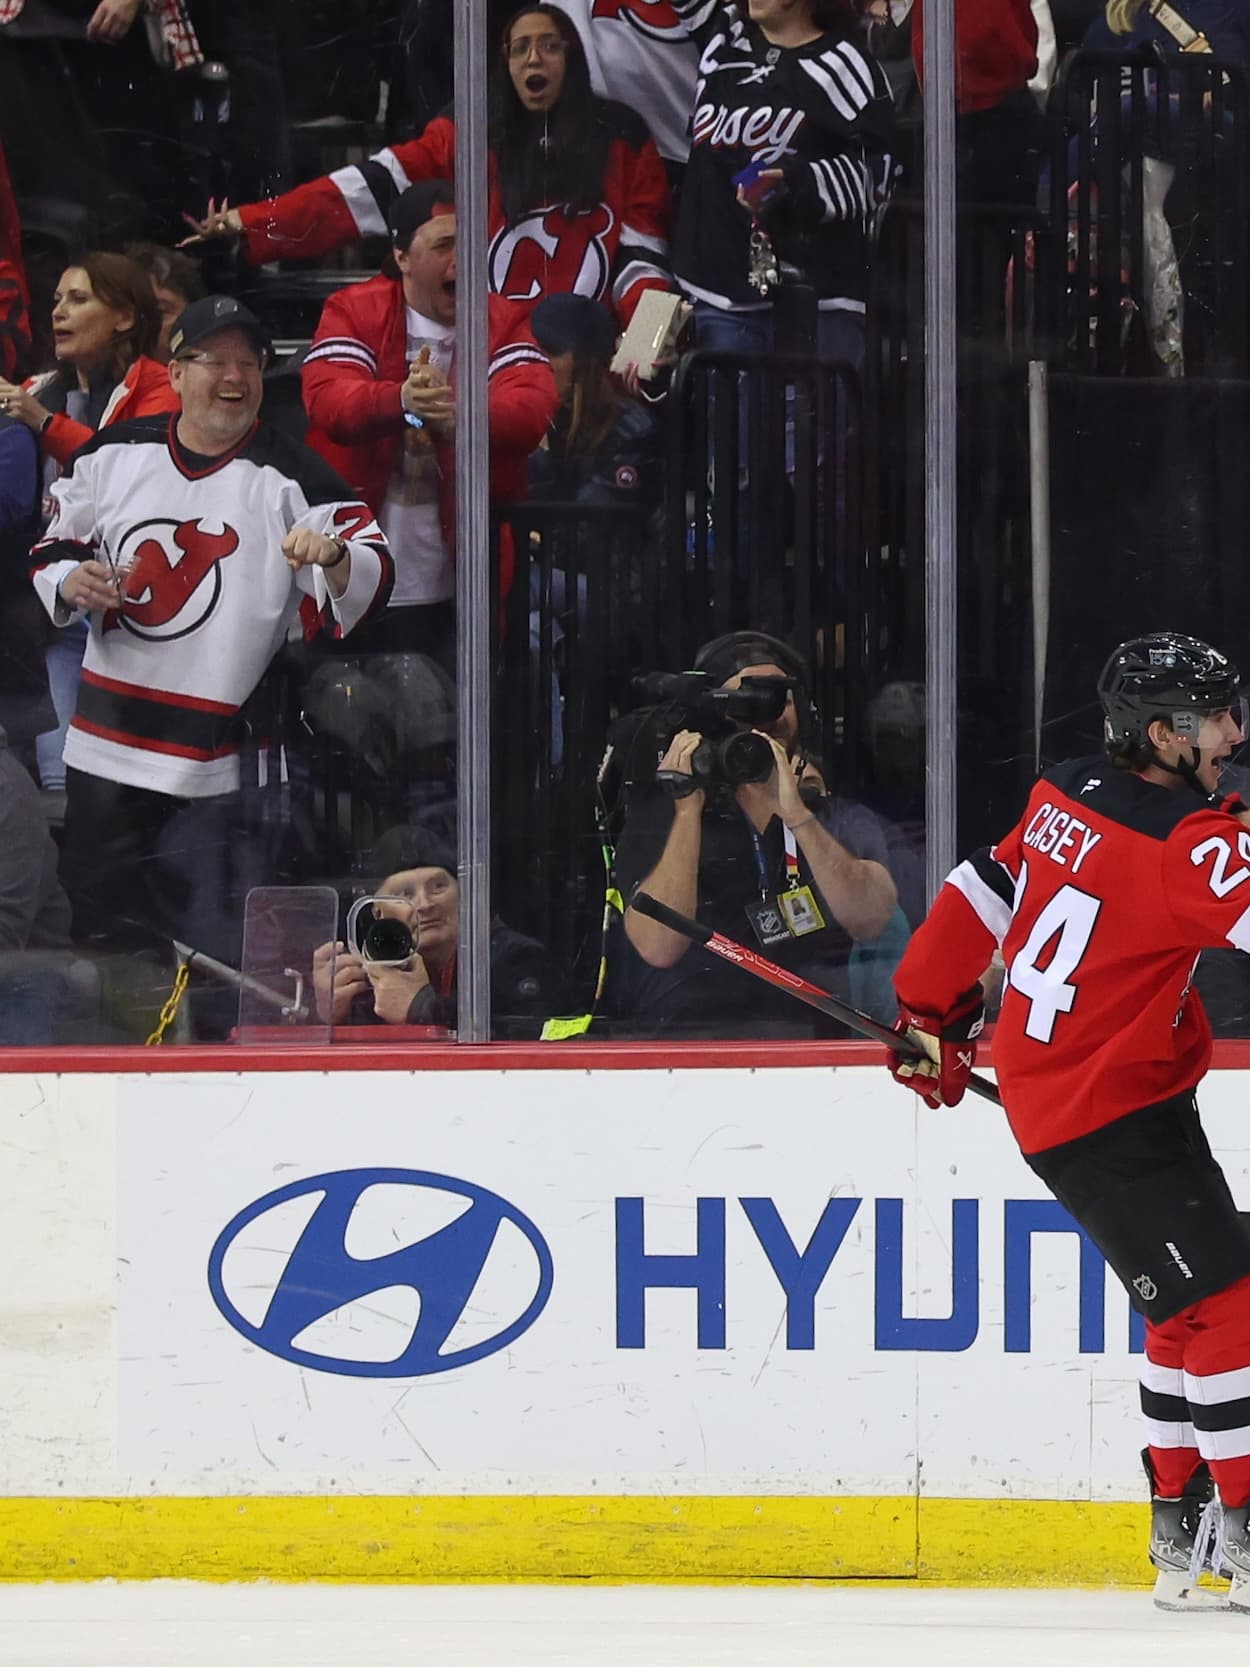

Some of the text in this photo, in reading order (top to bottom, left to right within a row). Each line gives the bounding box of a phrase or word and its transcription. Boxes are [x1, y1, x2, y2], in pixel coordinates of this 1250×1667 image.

[1023, 802, 1102, 874] CASEY
[706, 940, 744, 962] BAUER
[1001, 860, 1102, 1044] 4
[1165, 1242, 1194, 1279] BAUER
